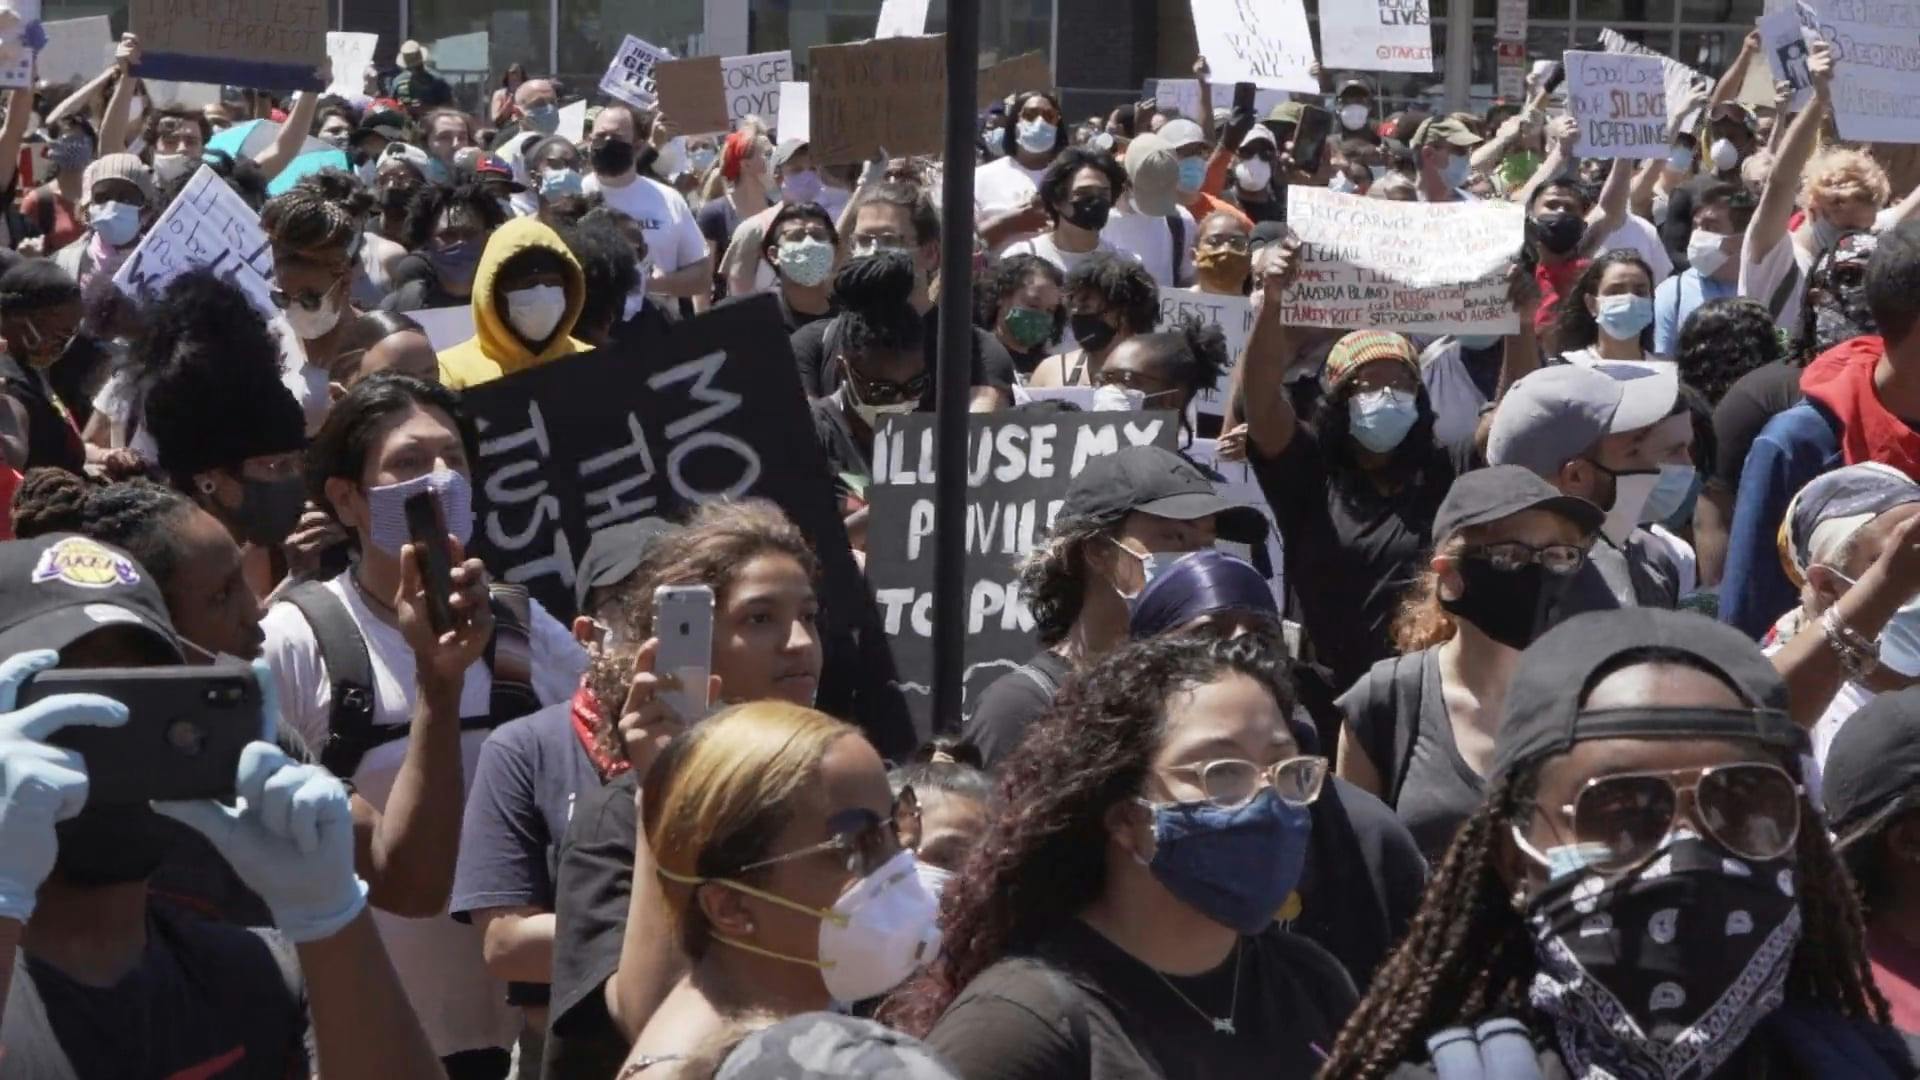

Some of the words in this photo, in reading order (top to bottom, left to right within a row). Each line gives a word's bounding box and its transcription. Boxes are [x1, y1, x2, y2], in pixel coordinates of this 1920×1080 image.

[1380, 9, 1430, 25] LIVES
[720, 59, 787, 91] ORGE
[733, 92, 779, 118] OYD
[1295, 268, 1341, 283] MMET
[646, 349, 762, 503] MO
[577, 410, 658, 530] TH
[966, 423, 1058, 488] USE
[907, 498, 1066, 561] PIVIL
